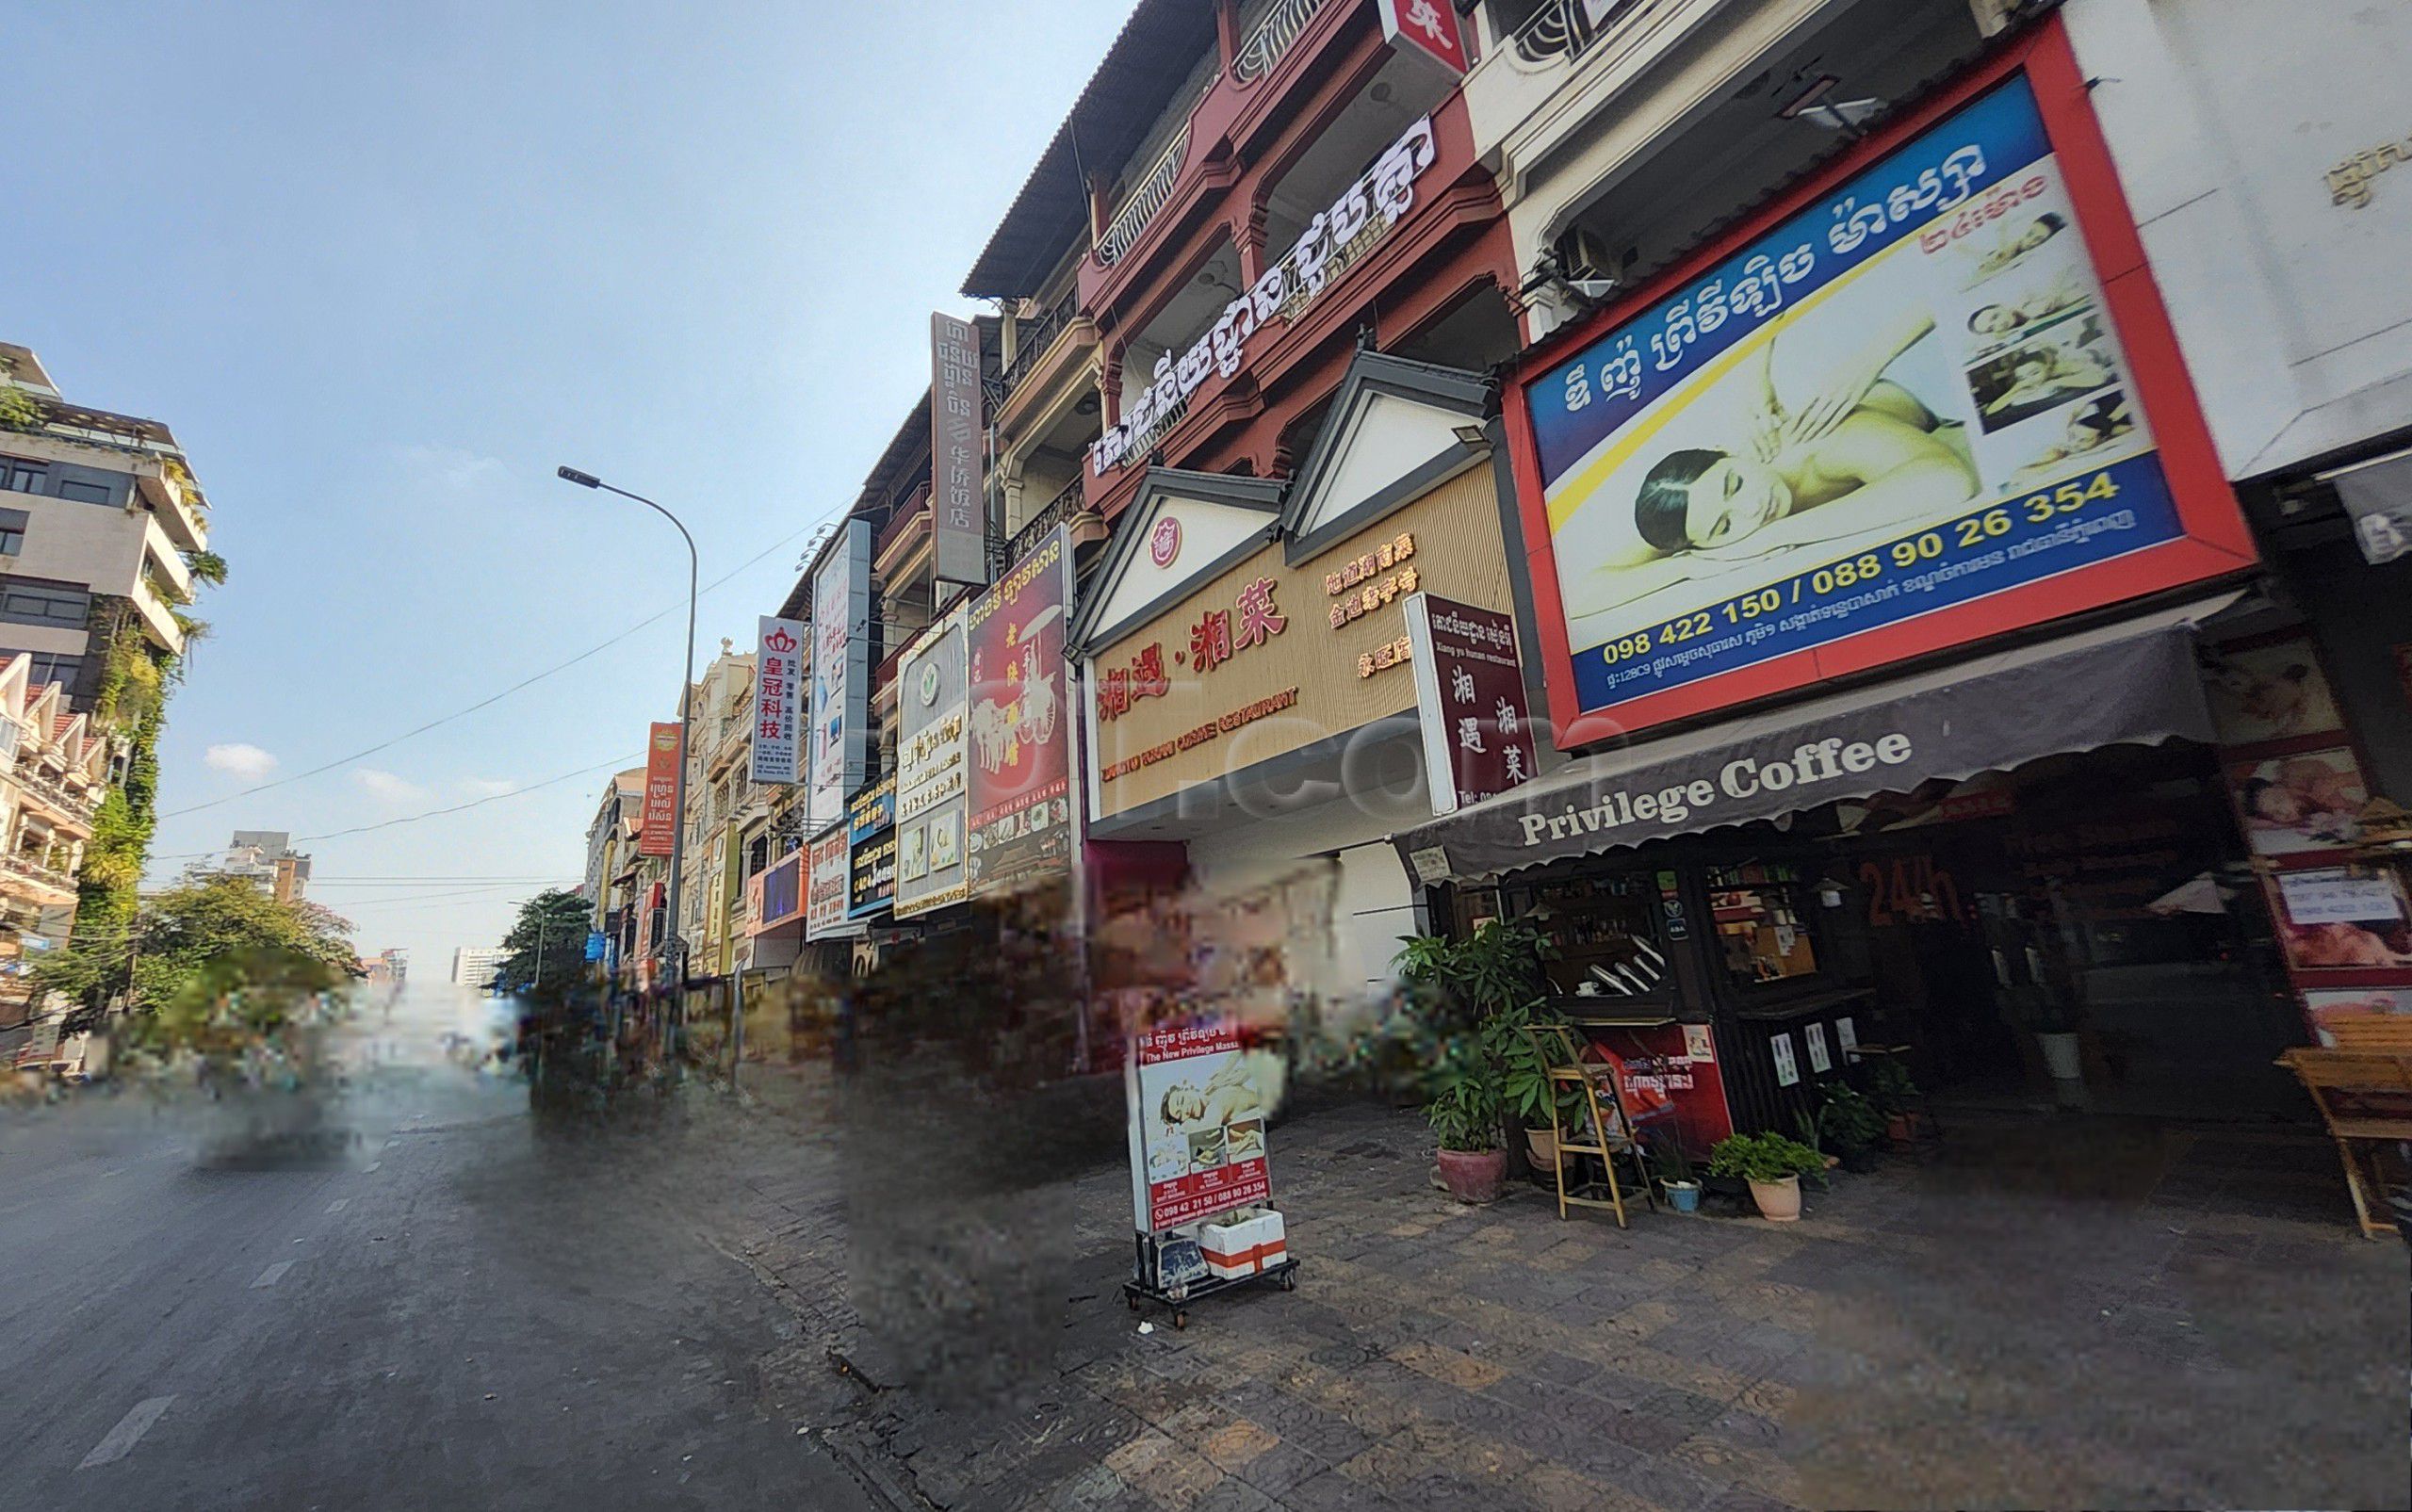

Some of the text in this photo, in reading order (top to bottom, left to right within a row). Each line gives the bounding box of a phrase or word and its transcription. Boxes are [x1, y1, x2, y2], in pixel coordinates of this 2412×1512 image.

[950, 444, 970, 528] 华侨饭店
[1325, 532, 1414, 595] 地道湖南菜
[1328, 565, 1418, 629] 金边老字号
[1603, 471, 2120, 665] 098 422 150 / 088 90 26 354
[759, 657, 784, 740] 皇冠科技
[1217, 686, 1298, 733] RESTAURANT
[1452, 664, 1487, 754] 湘遇
[1495, 696, 1528, 785] 湘菜
[1518, 732, 1913, 846] Privilege Coffee
[1147, 1041, 1239, 1063] The New Privilege Massa
